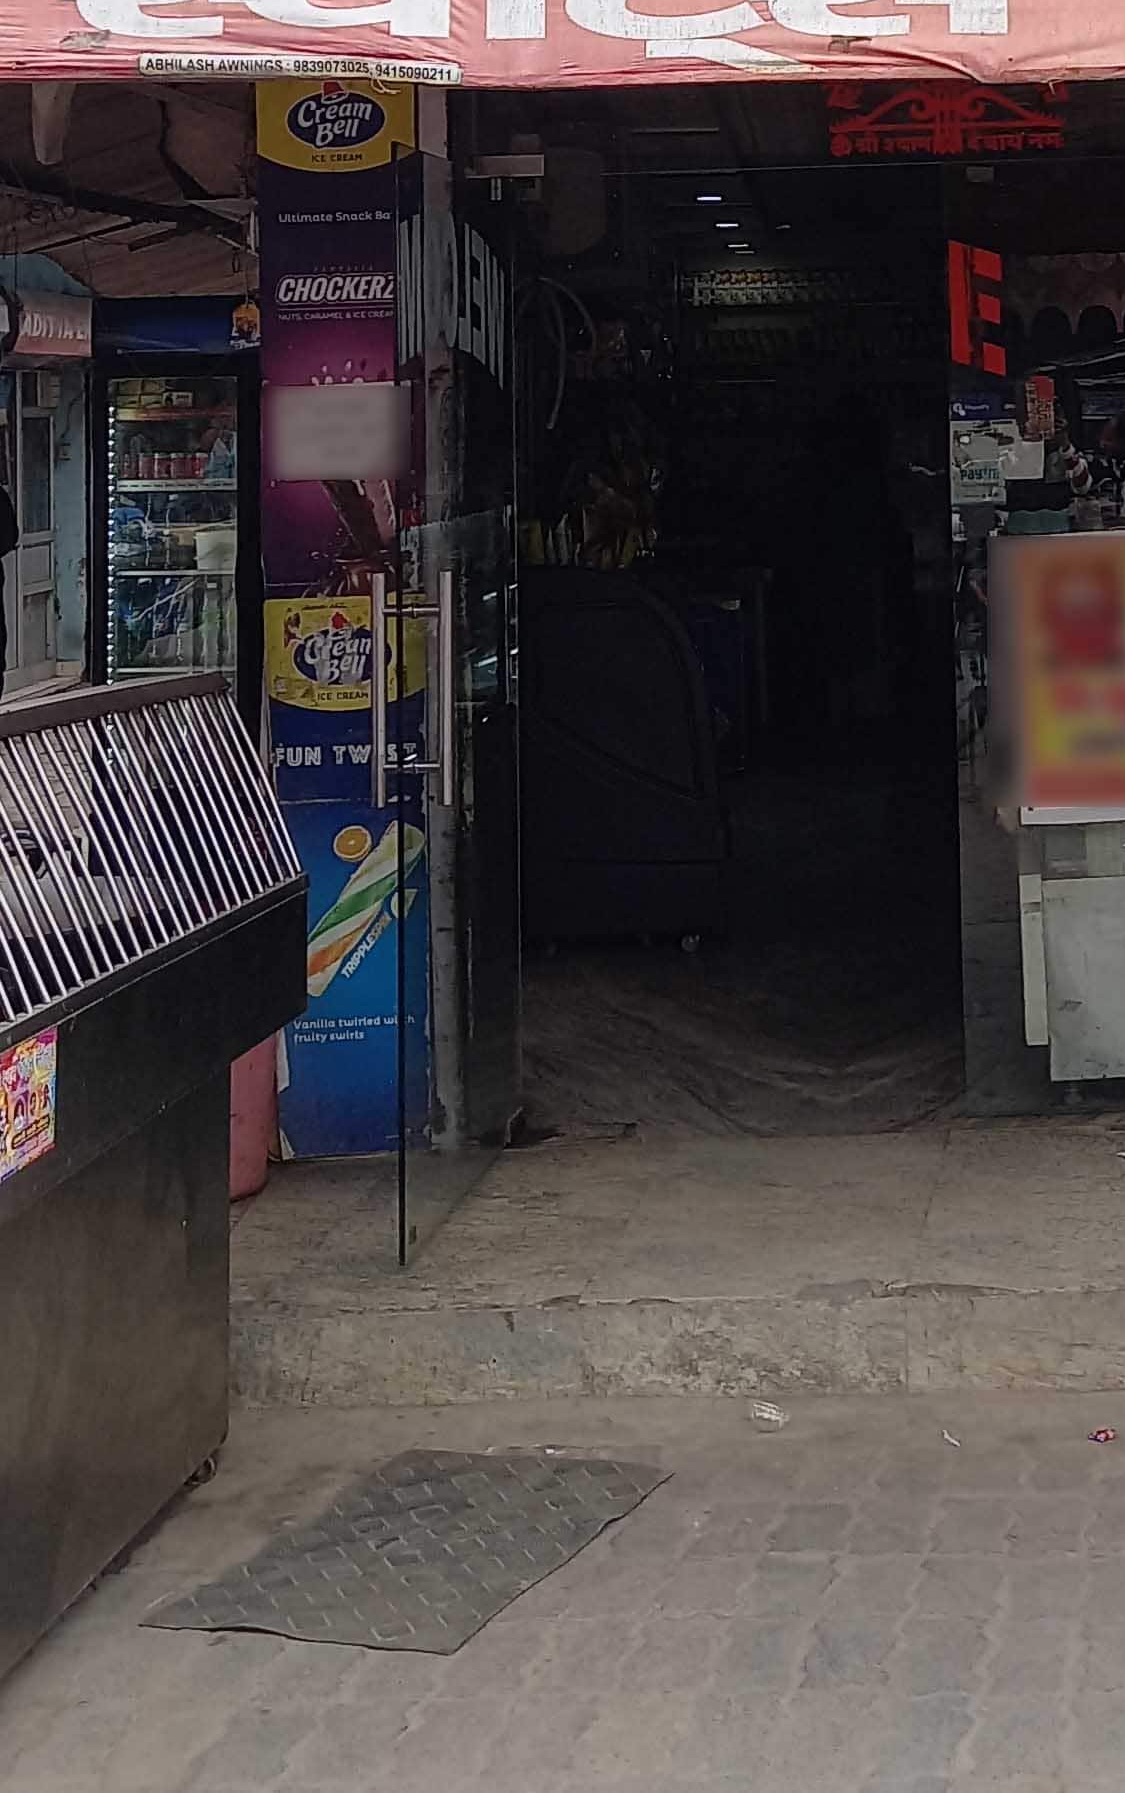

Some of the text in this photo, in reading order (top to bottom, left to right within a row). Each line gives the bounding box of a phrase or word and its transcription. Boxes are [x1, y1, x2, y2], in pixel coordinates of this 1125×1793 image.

[145, 58, 216, 73] ABHILASH
[218, 58, 282, 72] AWNINGS
[375, 62, 452, 81] 9415090211
[297, 100, 373, 128] Cream
[314, 117, 360, 148] Bell
[311, 153, 363, 163] ICE CREAM
[278, 211, 333, 224] Ultimate
[335, 210, 373, 222] Snack
[317, 691, 369, 701] ICE CREAM
[332, 742, 417, 765] TWST
[293, 1016, 336, 1031] Vanilla
[383, 1013, 415, 1025] wih
[293, 1031, 328, 1046] fruity
